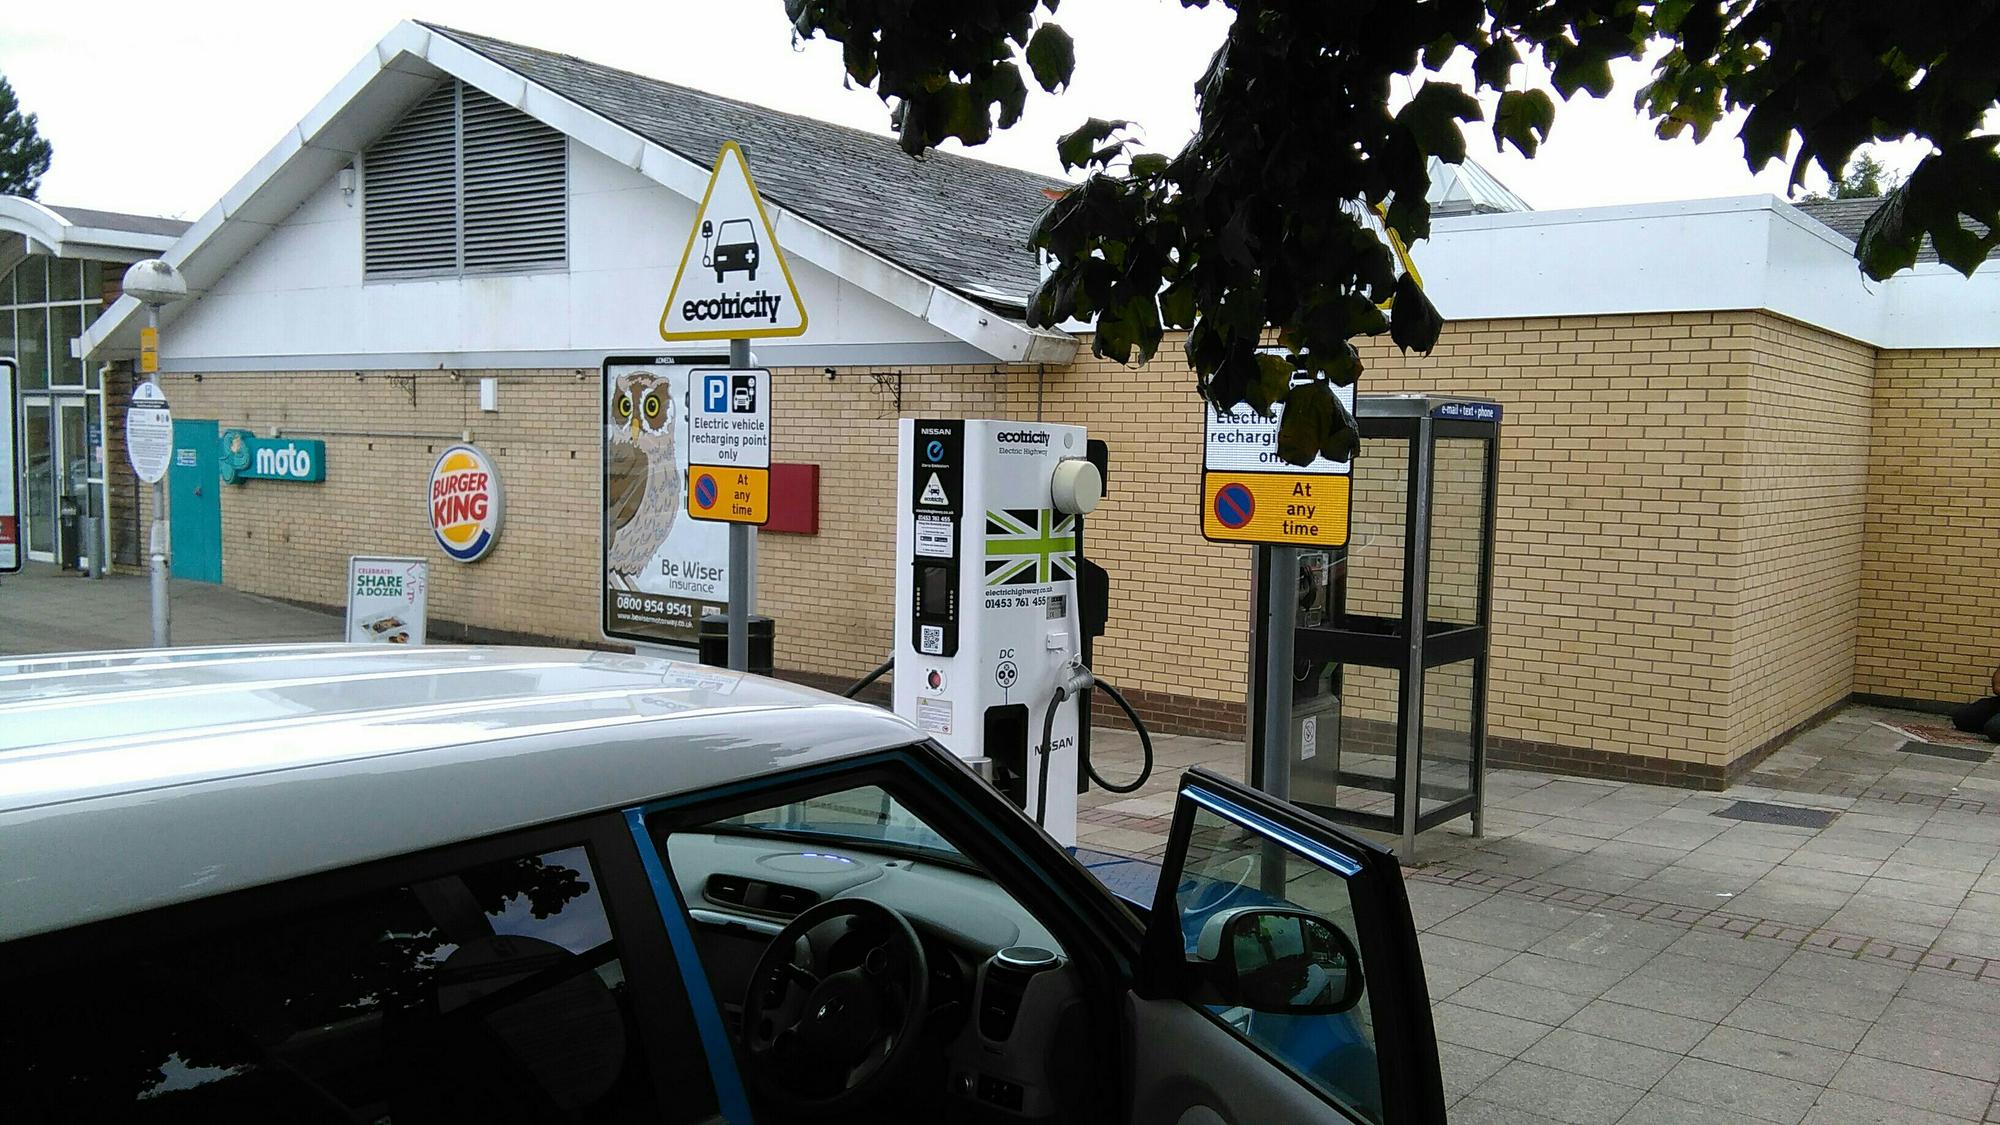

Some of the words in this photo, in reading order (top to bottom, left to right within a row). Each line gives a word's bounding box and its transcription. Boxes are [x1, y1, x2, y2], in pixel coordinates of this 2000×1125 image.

[682, 290, 781, 323] ecotricity
[709, 379, 725, 410] P
[1441, 404, 1459, 415] e-mail
[1463, 405, 1474, 416] text
[1477, 405, 1494, 419] phone
[695, 417, 729, 430] Electric
[732, 418, 765, 431] vehicle
[920, 428, 952, 436] NISSAN
[997, 430, 1050, 447] ecotricity
[1210, 429, 1276, 446] rechargi
[691, 433, 740, 447] recharging
[742, 434, 767, 448] point
[256, 442, 311, 477] moto
[718, 448, 738, 462] only
[998, 447, 1023, 455] Electric
[1023, 447, 1048, 457] Highway
[433, 472, 488, 500] BURGER
[737, 473, 749, 486] At
[734, 490, 751, 503] any
[1292, 481, 1312, 497] At
[434, 493, 488, 529] KING
[732, 504, 753, 516] time
[1286, 503, 1316, 519] any
[1282, 520, 1319, 536] time
[661, 558, 679, 577] Be
[682, 561, 724, 582] Wiser
[357, 575, 403, 588] SHARE
[669, 578, 715, 594] Insurance
[356, 587, 364, 596] A
[366, 587, 403, 597] DOZEN
[985, 586, 1053, 597] electrichighway.co.uk
[617, 596, 642, 611] 0800
[644, 599, 664, 614] 954
[666, 602, 693, 618] 9541
[985, 598, 1012, 609] 01453
[1015, 597, 1029, 607] 761
[1032, 595, 1046, 607] 455
[999, 648, 1015, 659] DC
[1034, 736, 1074, 757] NSAN
